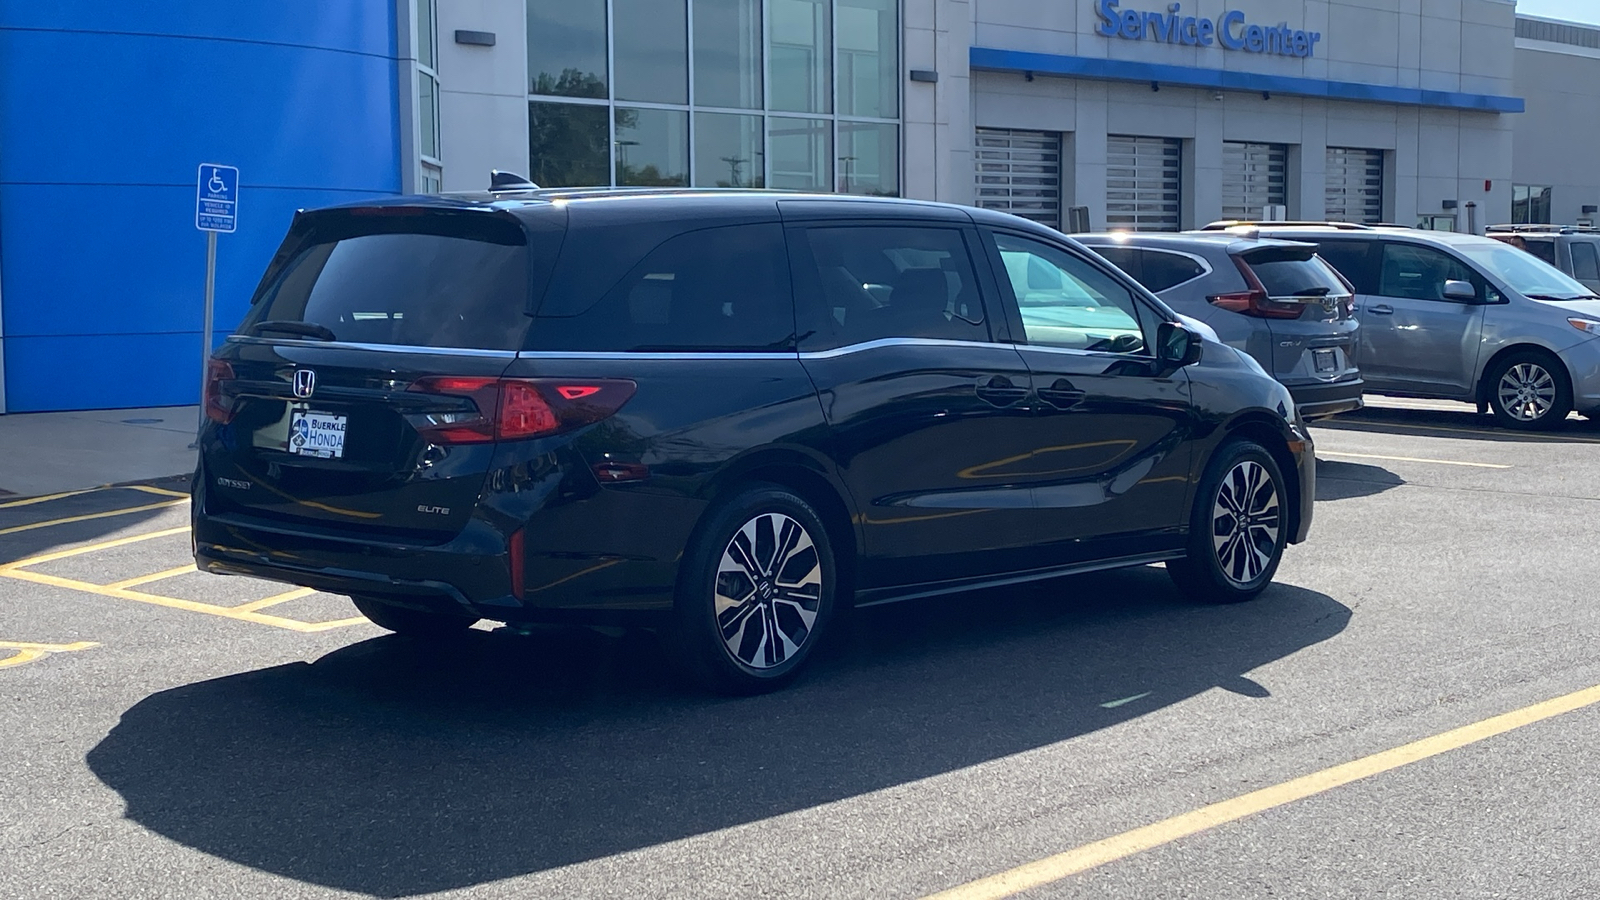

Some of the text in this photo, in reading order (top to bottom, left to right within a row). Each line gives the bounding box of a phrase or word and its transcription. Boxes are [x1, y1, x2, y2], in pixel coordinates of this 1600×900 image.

[1094, 0, 1321, 58] Service Center
[311, 419, 346, 432] BUERKLE
[309, 430, 343, 448] HONDA
[417, 504, 450, 515] ELITE
